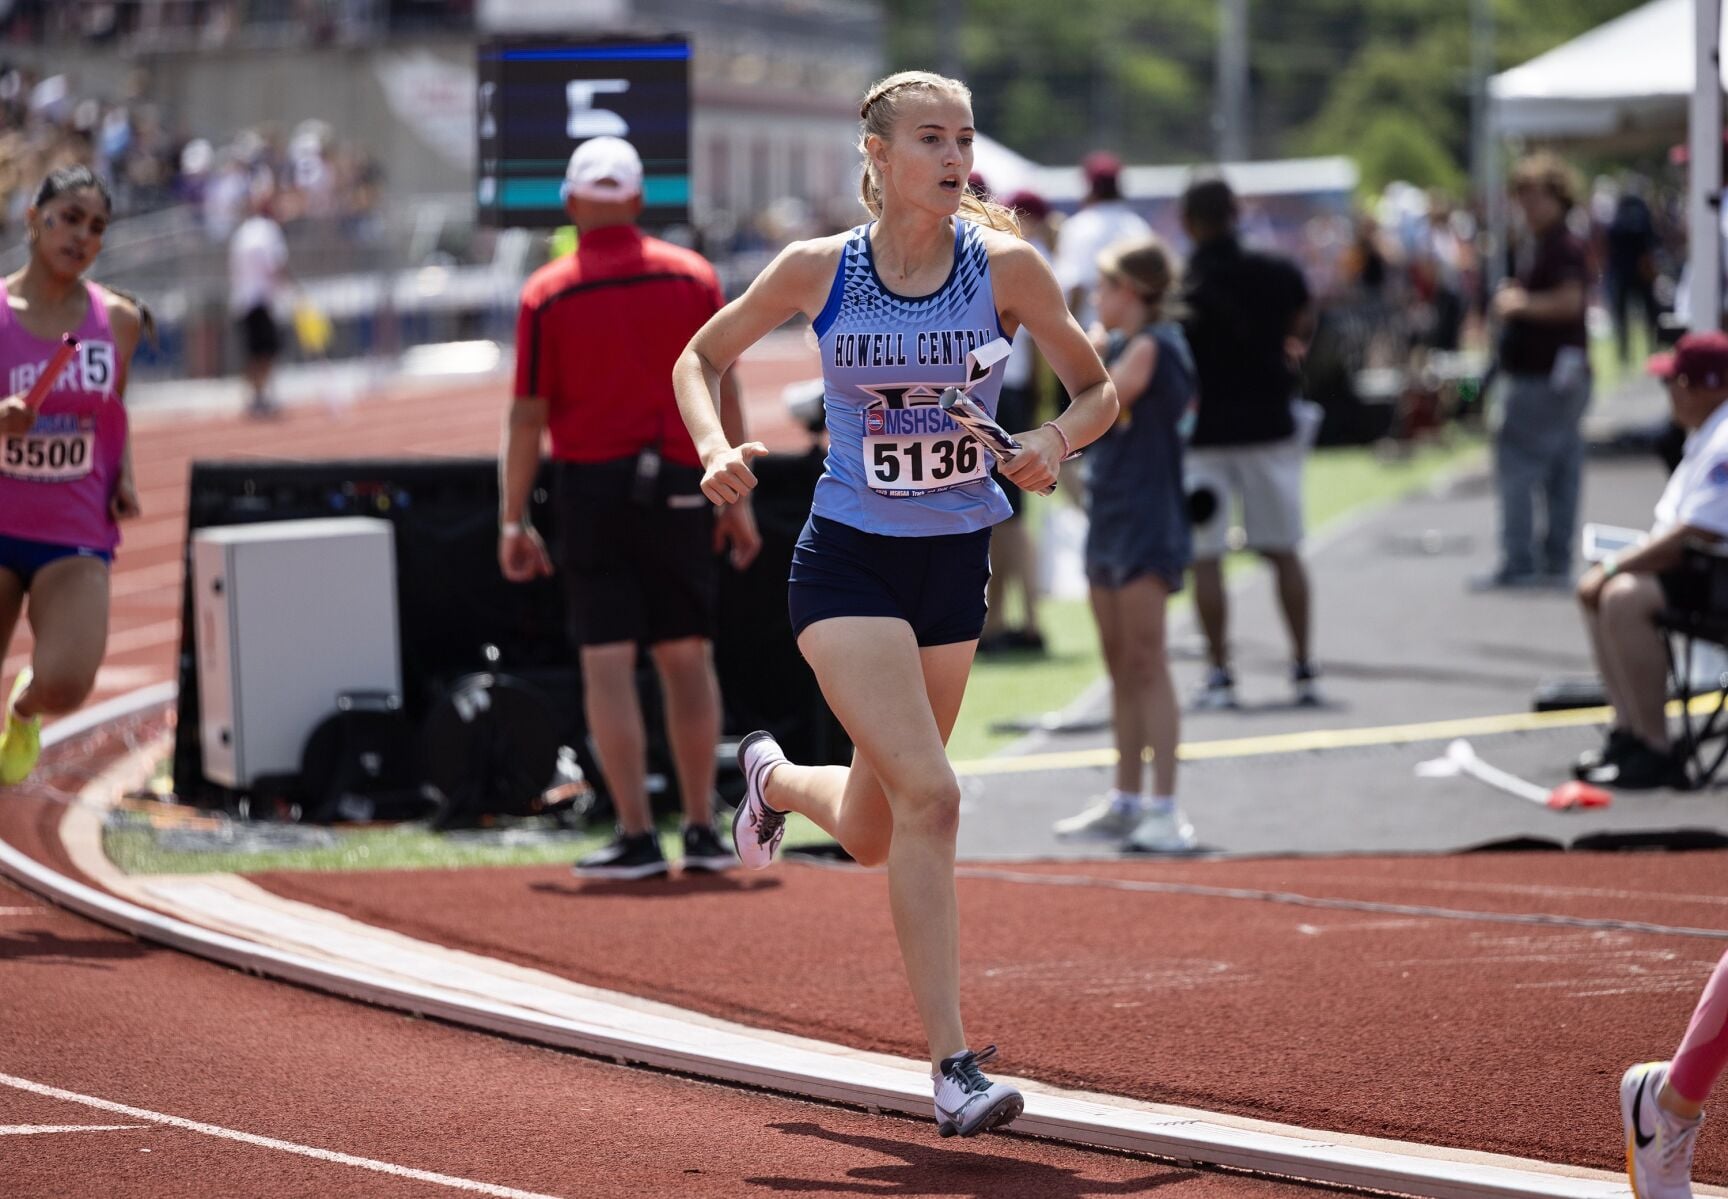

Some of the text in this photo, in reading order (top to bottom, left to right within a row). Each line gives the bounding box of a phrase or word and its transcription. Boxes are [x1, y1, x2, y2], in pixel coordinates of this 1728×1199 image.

[566, 79, 629, 138] 5
[87, 347, 108, 384] 5
[835, 329, 990, 368] HOWELL CENTR
[886, 408, 959, 434] MSHSA
[6, 438, 85, 468] 5500
[874, 435, 977, 482] 5136
